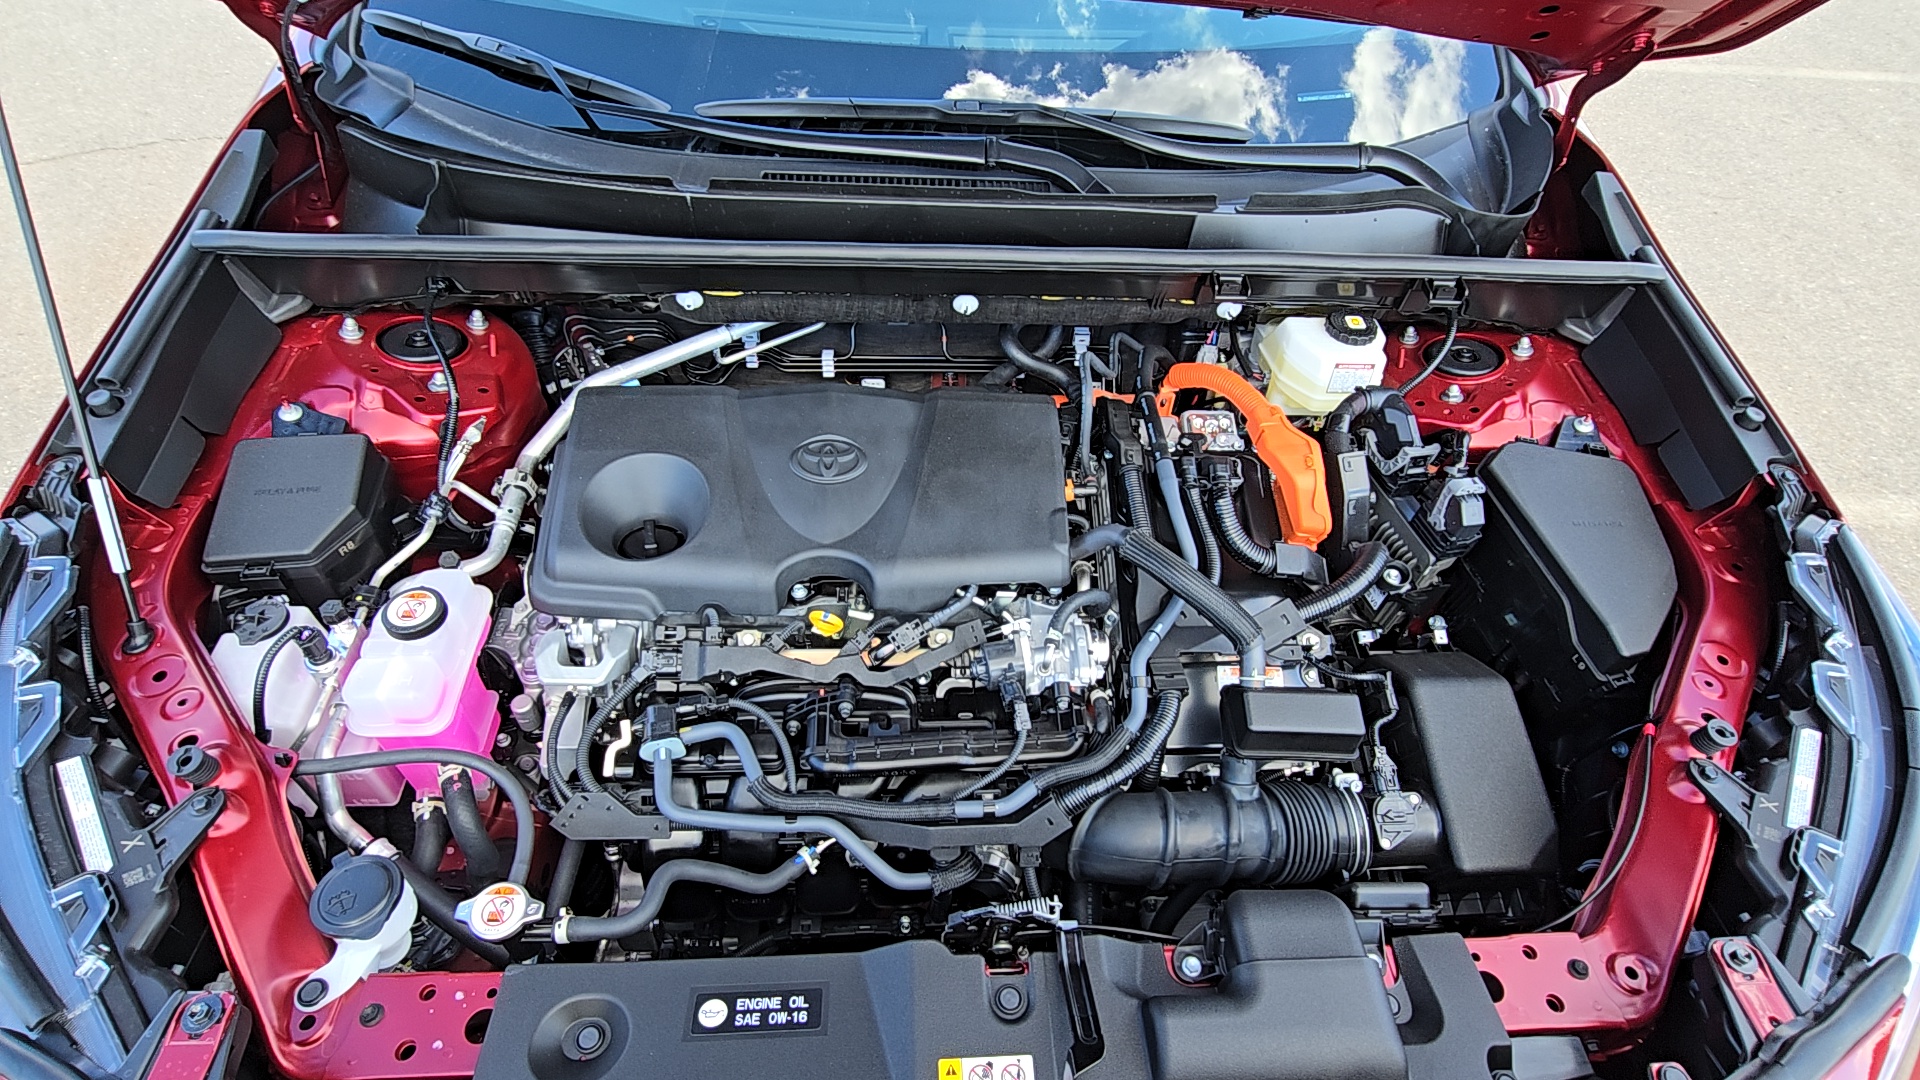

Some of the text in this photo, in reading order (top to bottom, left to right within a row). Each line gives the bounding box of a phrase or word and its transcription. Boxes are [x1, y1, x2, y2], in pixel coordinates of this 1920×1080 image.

[338, 540, 355, 557] R8
[736, 995, 809, 1010] ENGINE OIL
[734, 1010, 808, 1026] SAE 0W-16
